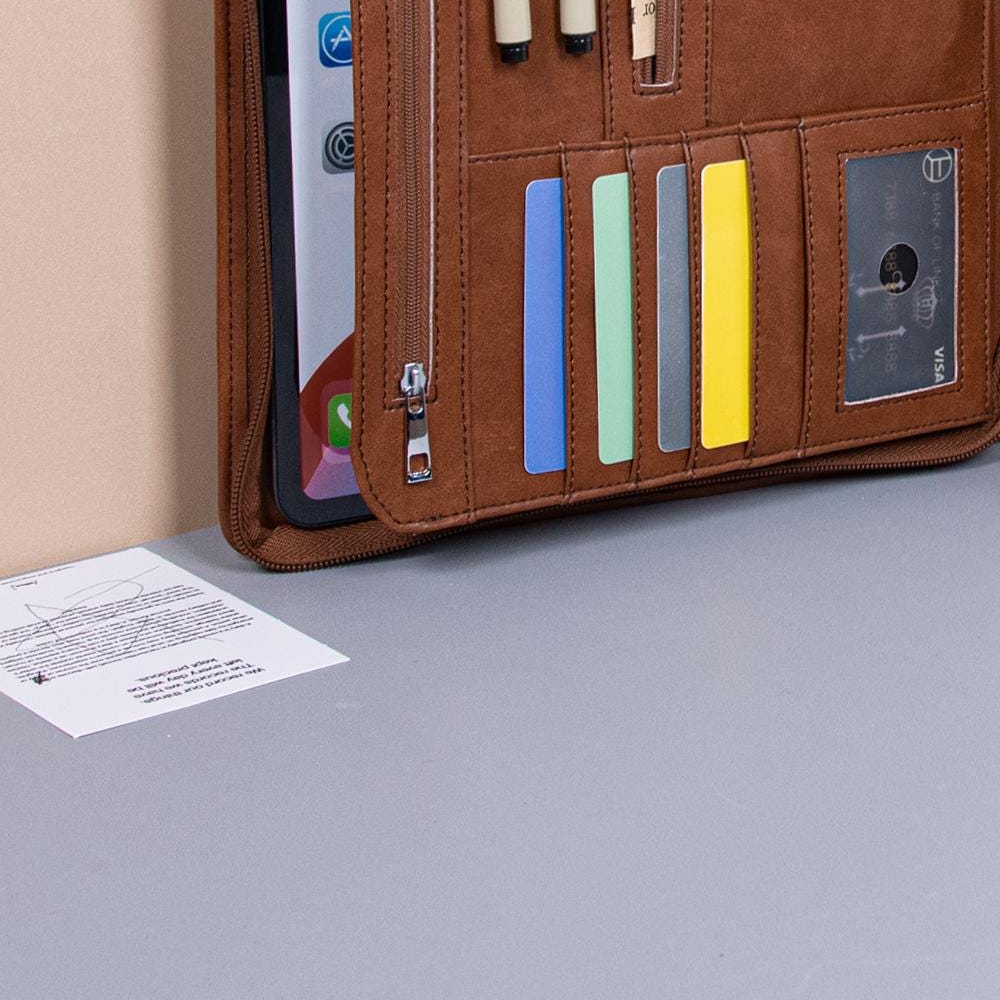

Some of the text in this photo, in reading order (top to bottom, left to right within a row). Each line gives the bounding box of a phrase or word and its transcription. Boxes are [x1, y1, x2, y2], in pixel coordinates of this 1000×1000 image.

[933, 347, 945, 383] VISA
[183, 670, 229, 685] records
[205, 673, 243, 687] record
